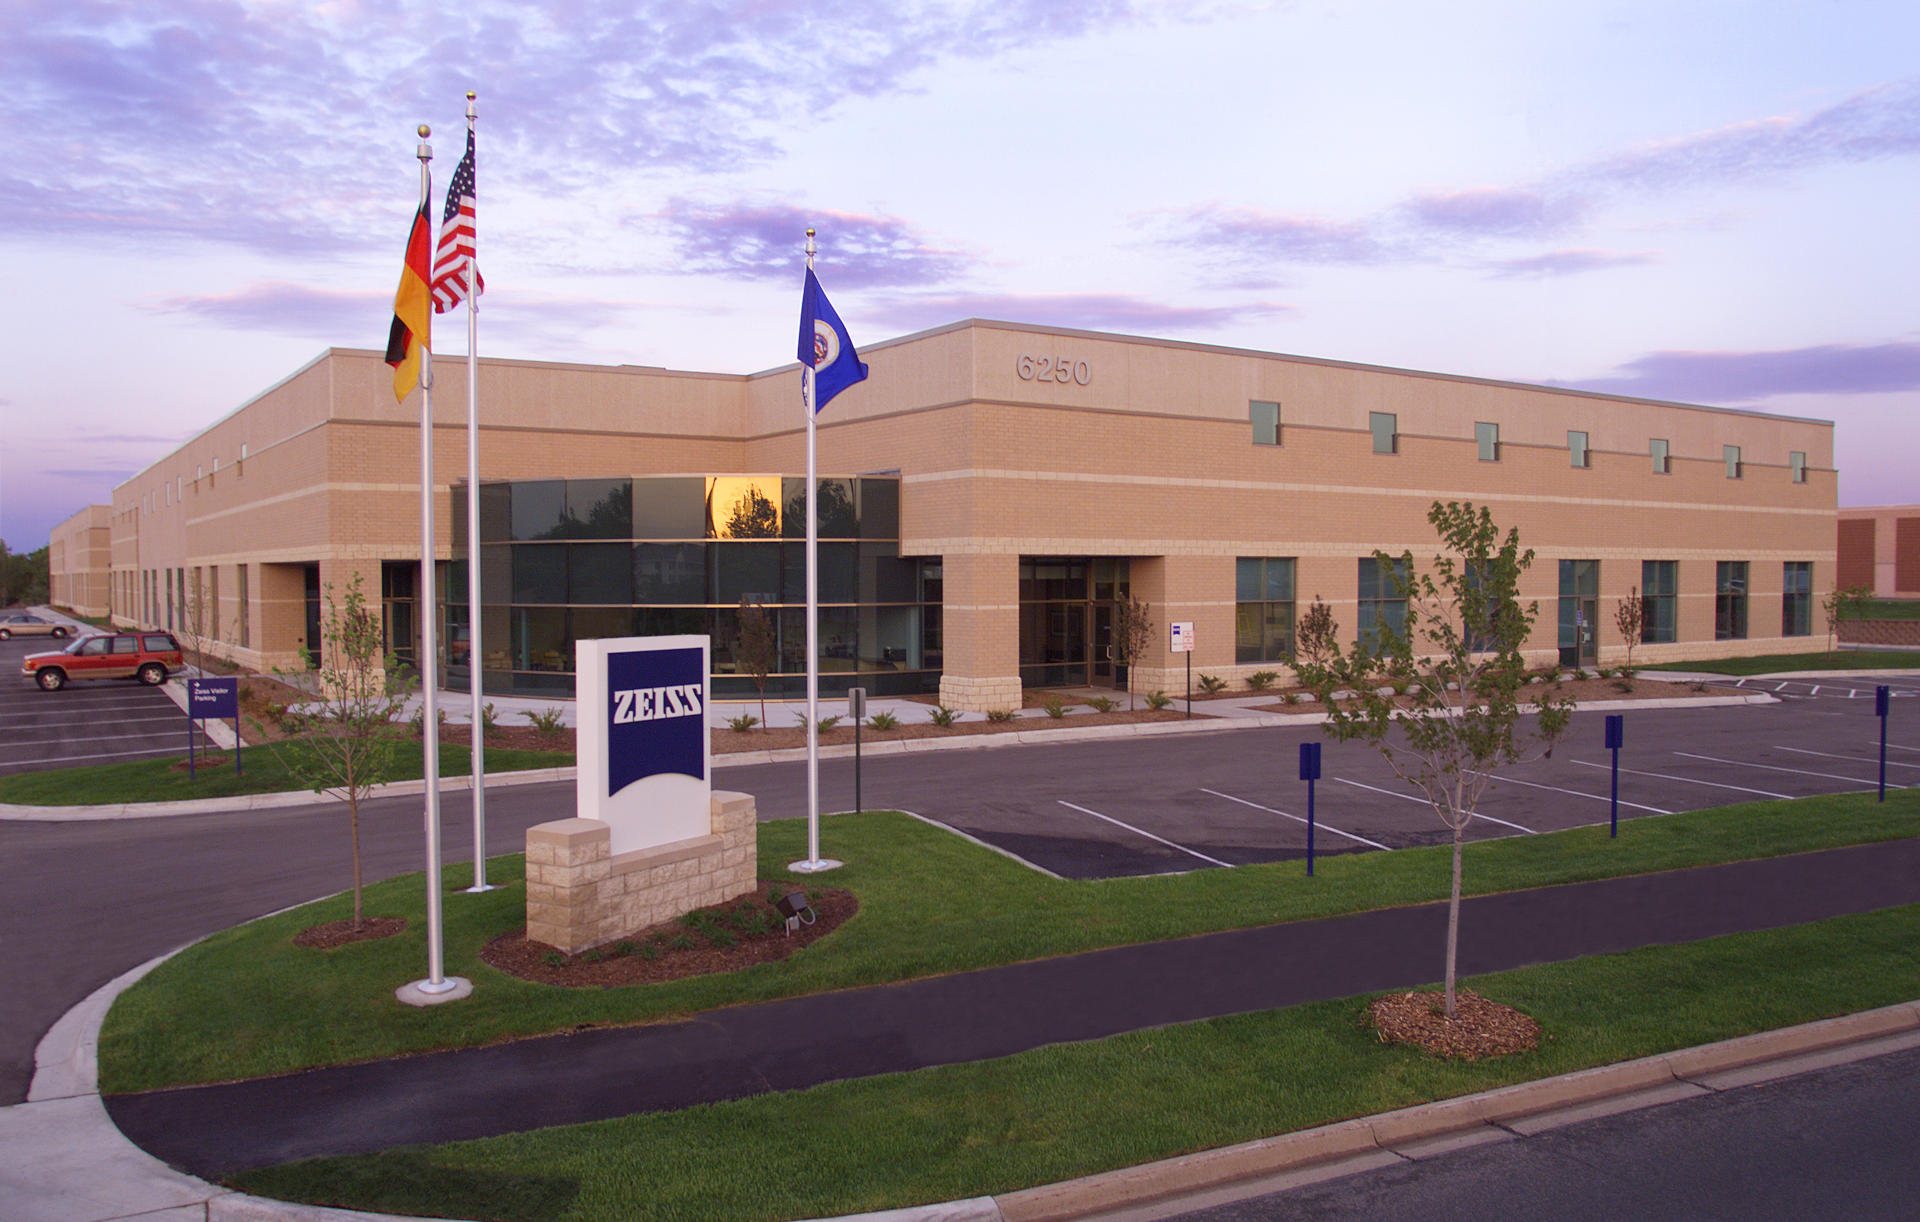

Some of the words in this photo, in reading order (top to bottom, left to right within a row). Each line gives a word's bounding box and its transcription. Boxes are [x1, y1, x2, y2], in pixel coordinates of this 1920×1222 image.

[1017, 353, 1092, 386] 6250
[194, 695, 217, 703] Parking
[614, 684, 702, 724] ZEISS
